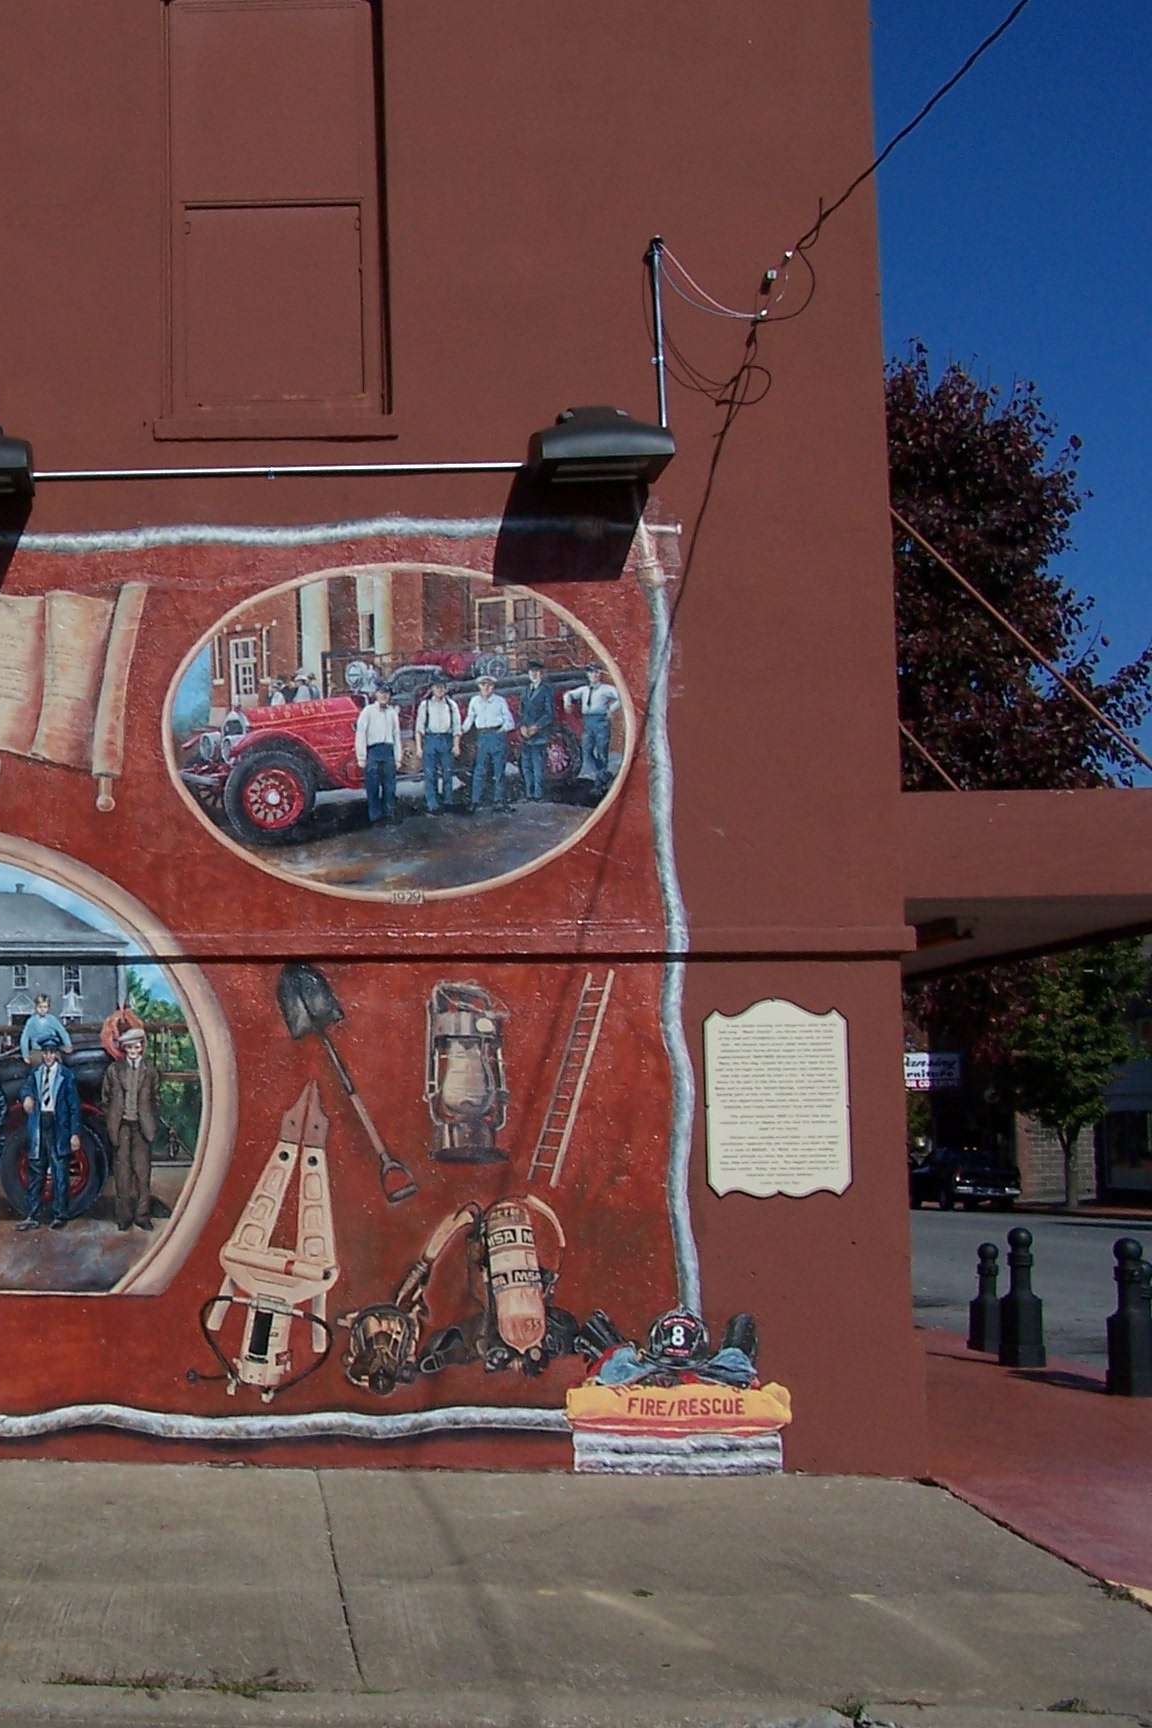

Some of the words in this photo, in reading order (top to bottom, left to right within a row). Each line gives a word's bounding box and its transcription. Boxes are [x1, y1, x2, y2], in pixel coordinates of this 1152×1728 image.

[513, 1271, 542, 1283] MSA
[671, 1322, 685, 1346] 8
[627, 1397, 746, 1417] FIRE/RESCUE
